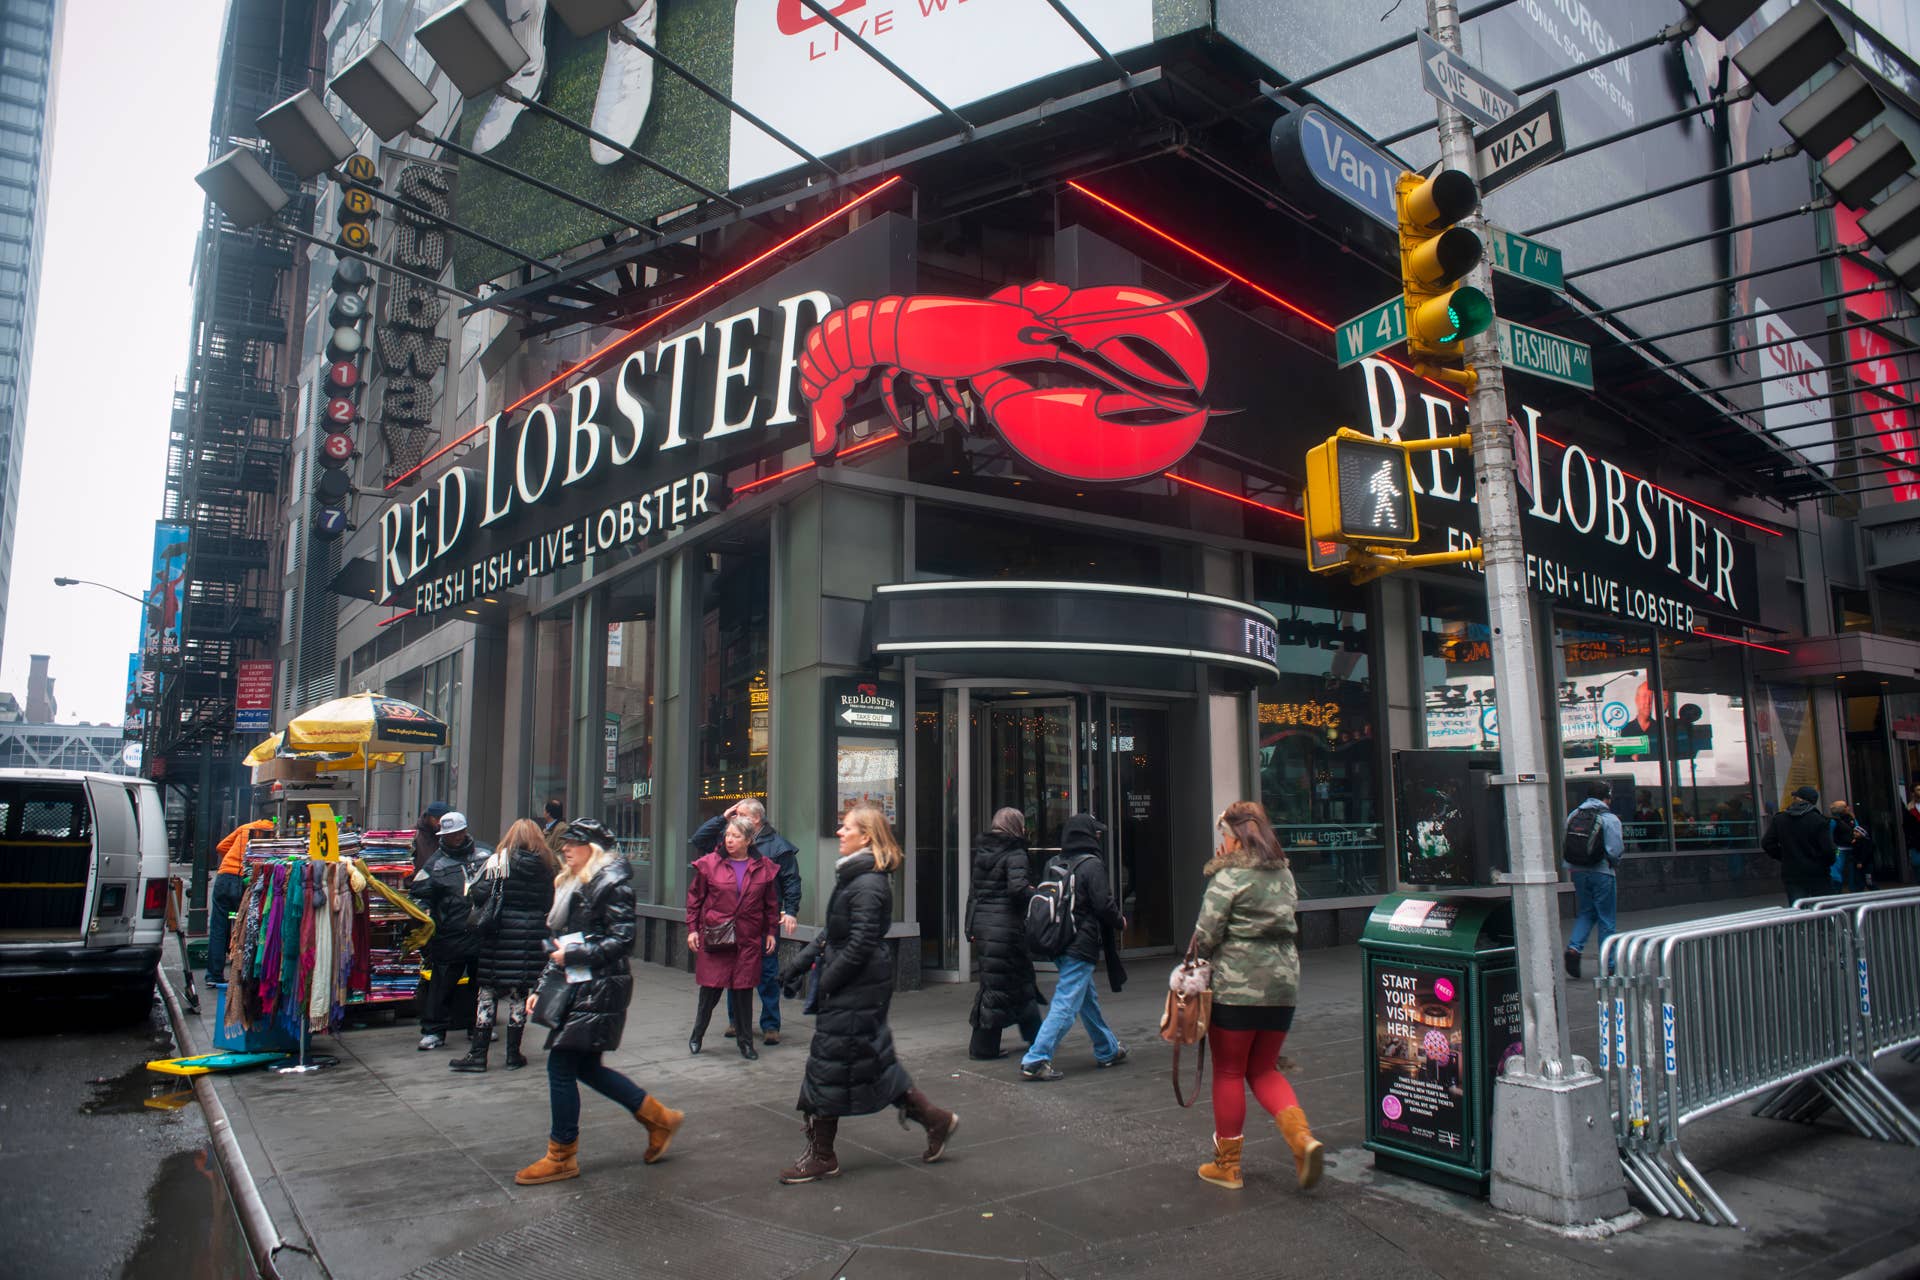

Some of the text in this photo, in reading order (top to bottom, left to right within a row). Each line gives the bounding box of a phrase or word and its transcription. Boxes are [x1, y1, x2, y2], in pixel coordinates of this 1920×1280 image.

[1553, 0, 1632, 85] ORGAN
[1437, 60, 1509, 120] ONE WAY
[1312, 120, 1377, 199] Van
[1490, 119, 1540, 168] WAY
[1513, 239, 1549, 274] 7 AV
[325, 158, 369, 528] N R Q S 1 2 3 7
[1346, 303, 1403, 358] W 41
[1513, 329, 1588, 377] FASHION AV
[1359, 356, 1479, 504] RE
[1521, 404, 1739, 611] LOBSTER
[378, 465, 468, 606] RED
[415, 471, 710, 617] FRESH FISH LIVE LOBSTER
[1526, 553, 1694, 634] FISH LIVE LOBSTER
[841, 695, 859, 705] RED
[860, 694, 895, 708] LOBSTER
[1290, 831, 1358, 843] LIVE LOBSTER
[1381, 973, 1418, 991] START
[1385, 989, 1416, 1007] YOUR
[1858, 960, 1869, 1013] NYPD
[1386, 1006, 1416, 1023] VISIT
[1387, 1022, 1417, 1039] HERE
[1493, 1005, 1505, 1015] THE
[1508, 1014, 1521, 1024] YEA
[1615, 1000, 1625, 1066] NYPD
[1663, 1006, 1676, 1072] NYPD
